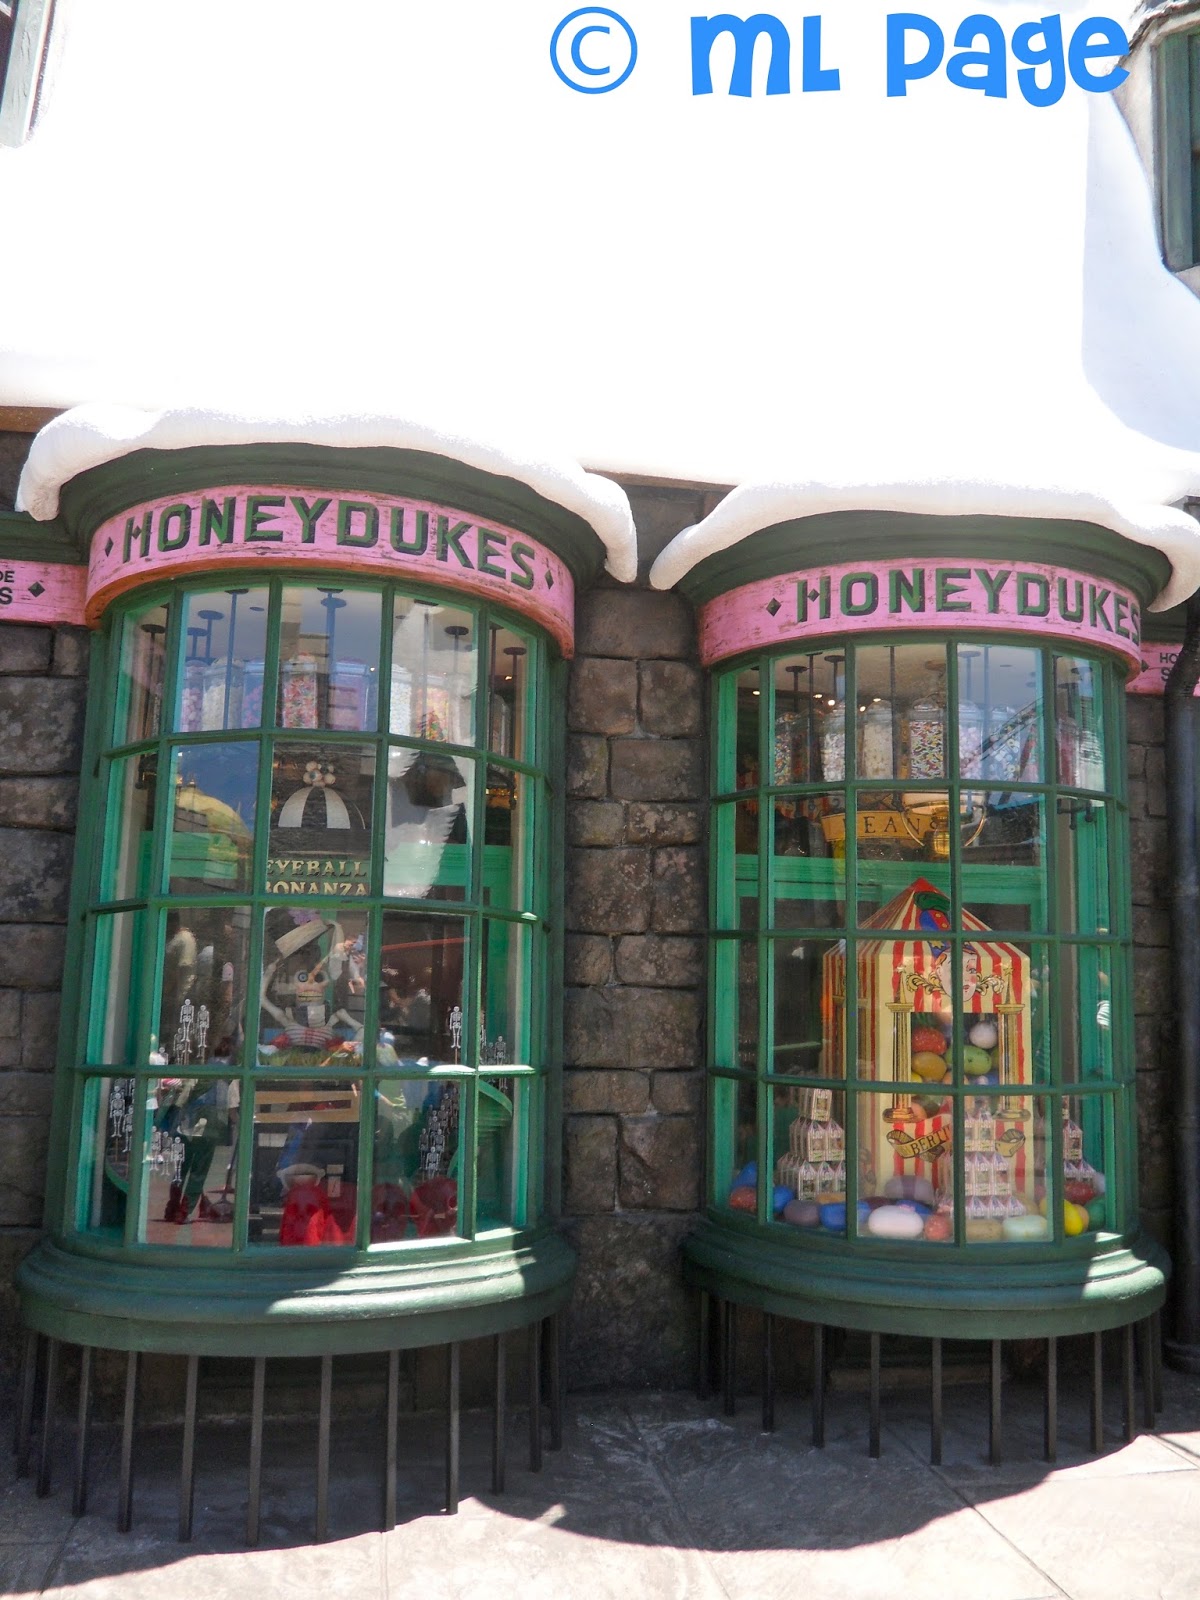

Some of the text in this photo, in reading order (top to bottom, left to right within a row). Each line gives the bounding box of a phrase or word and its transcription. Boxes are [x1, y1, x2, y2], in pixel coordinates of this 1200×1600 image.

[122, 496, 536, 591] HONEYDUKES
[796, 567, 1140, 647] HONEYDUKES
[843, 815, 938, 835] EAN
[266, 859, 367, 877] EYEBALL
